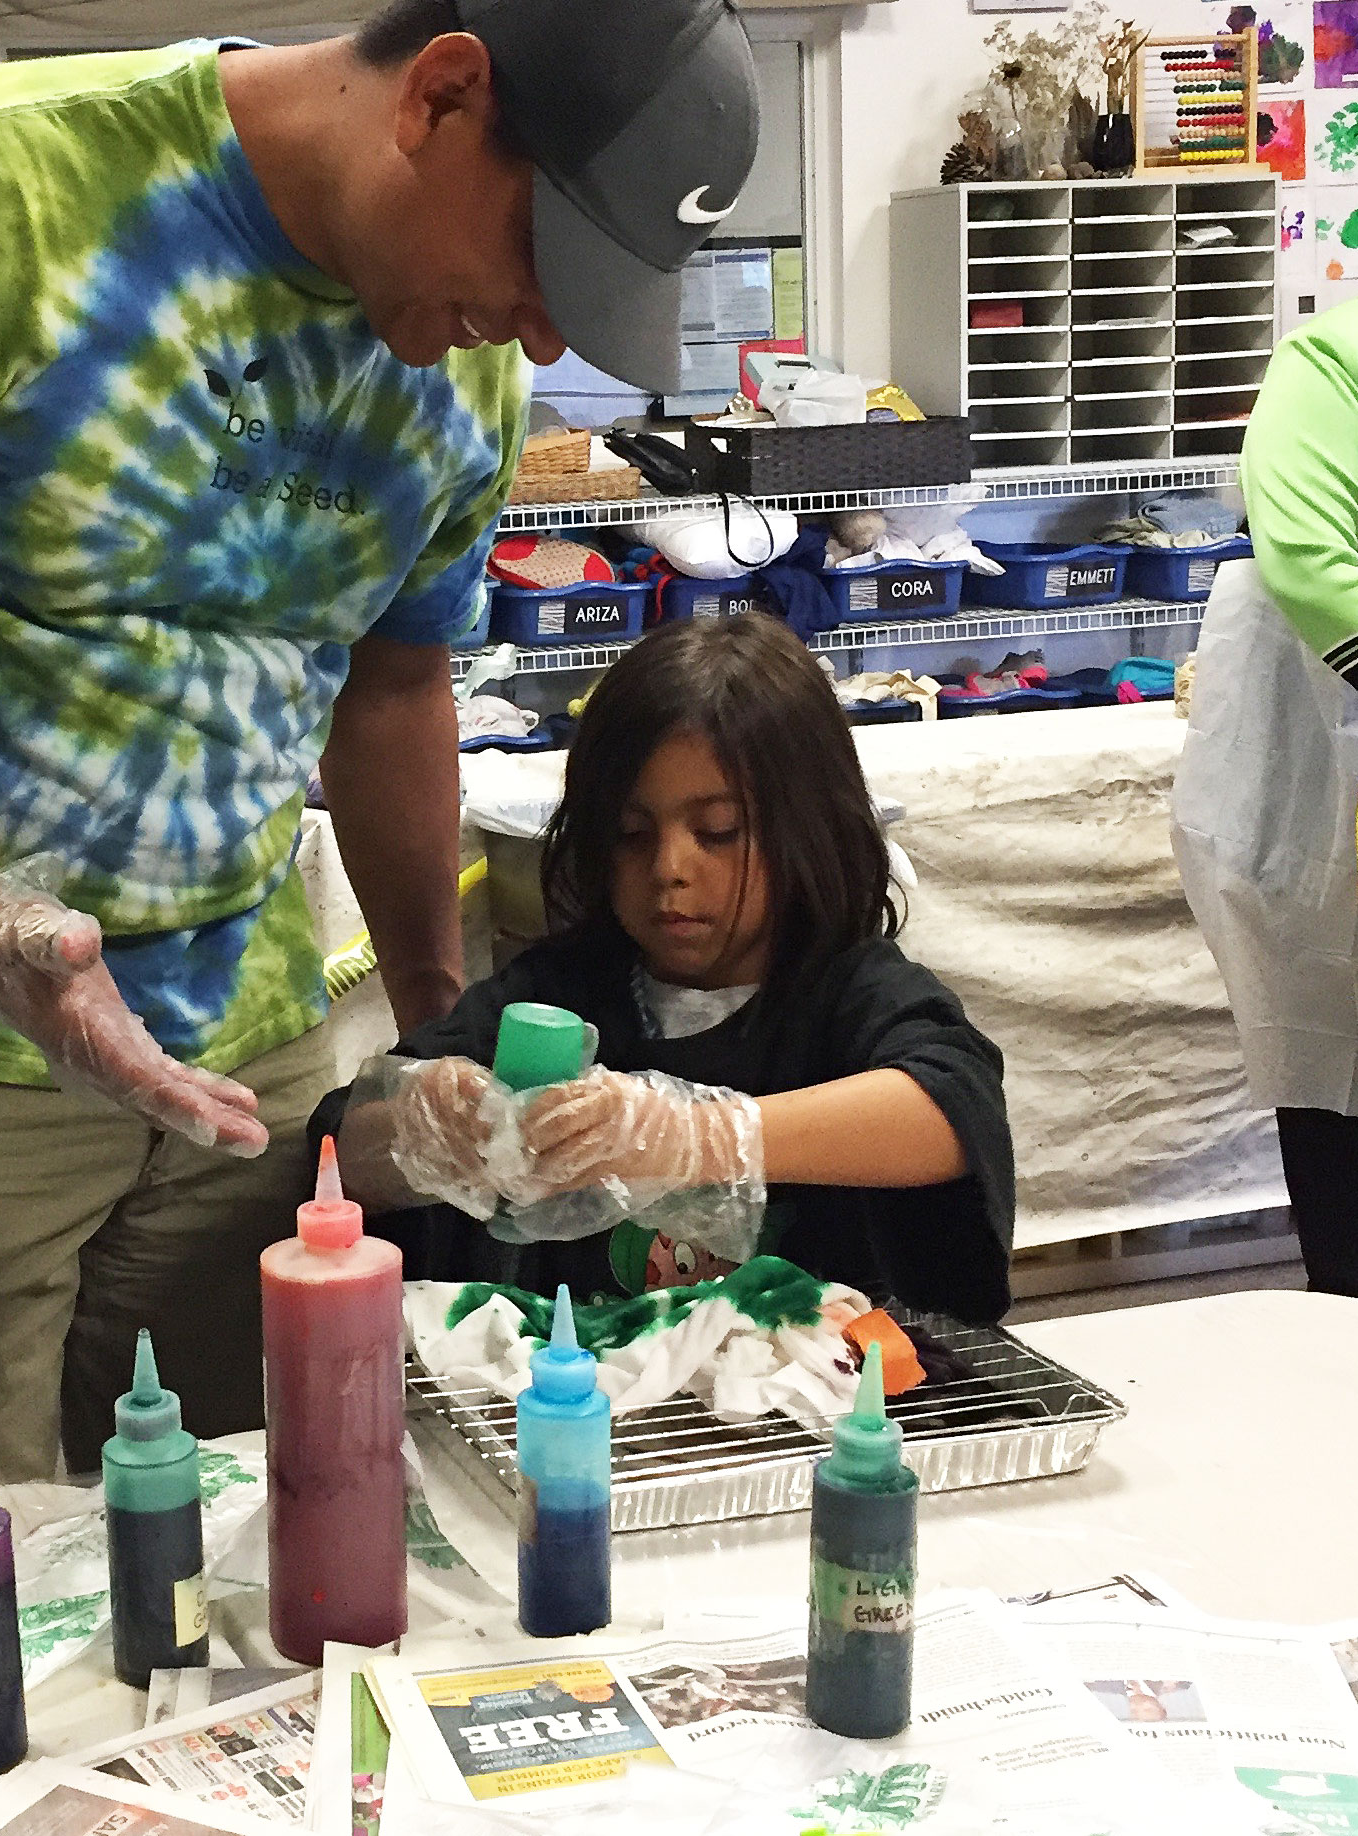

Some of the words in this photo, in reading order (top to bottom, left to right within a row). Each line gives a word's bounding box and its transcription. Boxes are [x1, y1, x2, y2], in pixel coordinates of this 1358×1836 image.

[222, 401, 266, 443] be
[209, 455, 250, 494] be
[254, 478, 273, 499] a
[1069, 566, 1116, 588] EMMETT
[891, 581, 934, 598] CORA
[575, 606, 621, 623] ARIZA
[917, 1688, 1054, 1723] Goldschmidt
[457, 1707, 630, 1755] FREE
[495, 1767, 560, 1783] SUMMER
[516, 1775, 573, 1791] DRAINS
[577, 1768, 617, 1781] YOUR
[497, 1783, 514, 1793] IN
